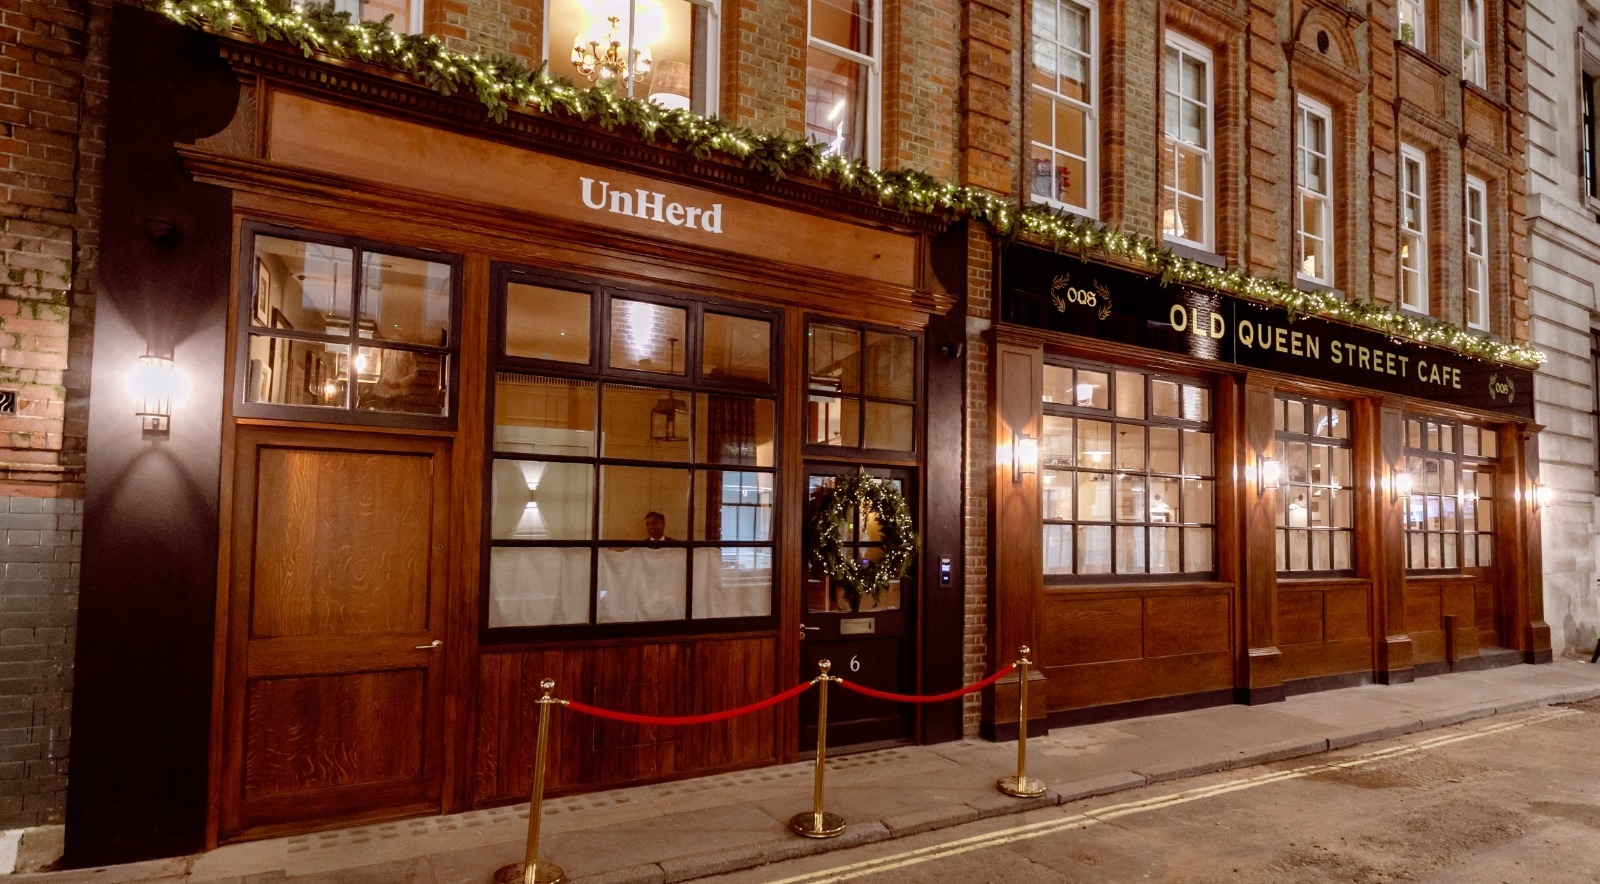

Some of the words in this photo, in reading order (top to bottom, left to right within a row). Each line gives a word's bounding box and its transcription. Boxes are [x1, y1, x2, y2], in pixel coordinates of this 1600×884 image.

[580, 176, 723, 234] UnHerd
[1169, 304, 1225, 339] OLD
[1238, 320, 1320, 359] QUEEN
[1330, 340, 1409, 377] STREET
[1417, 360, 1462, 389] CAFE
[850, 655, 860, 672] 6
